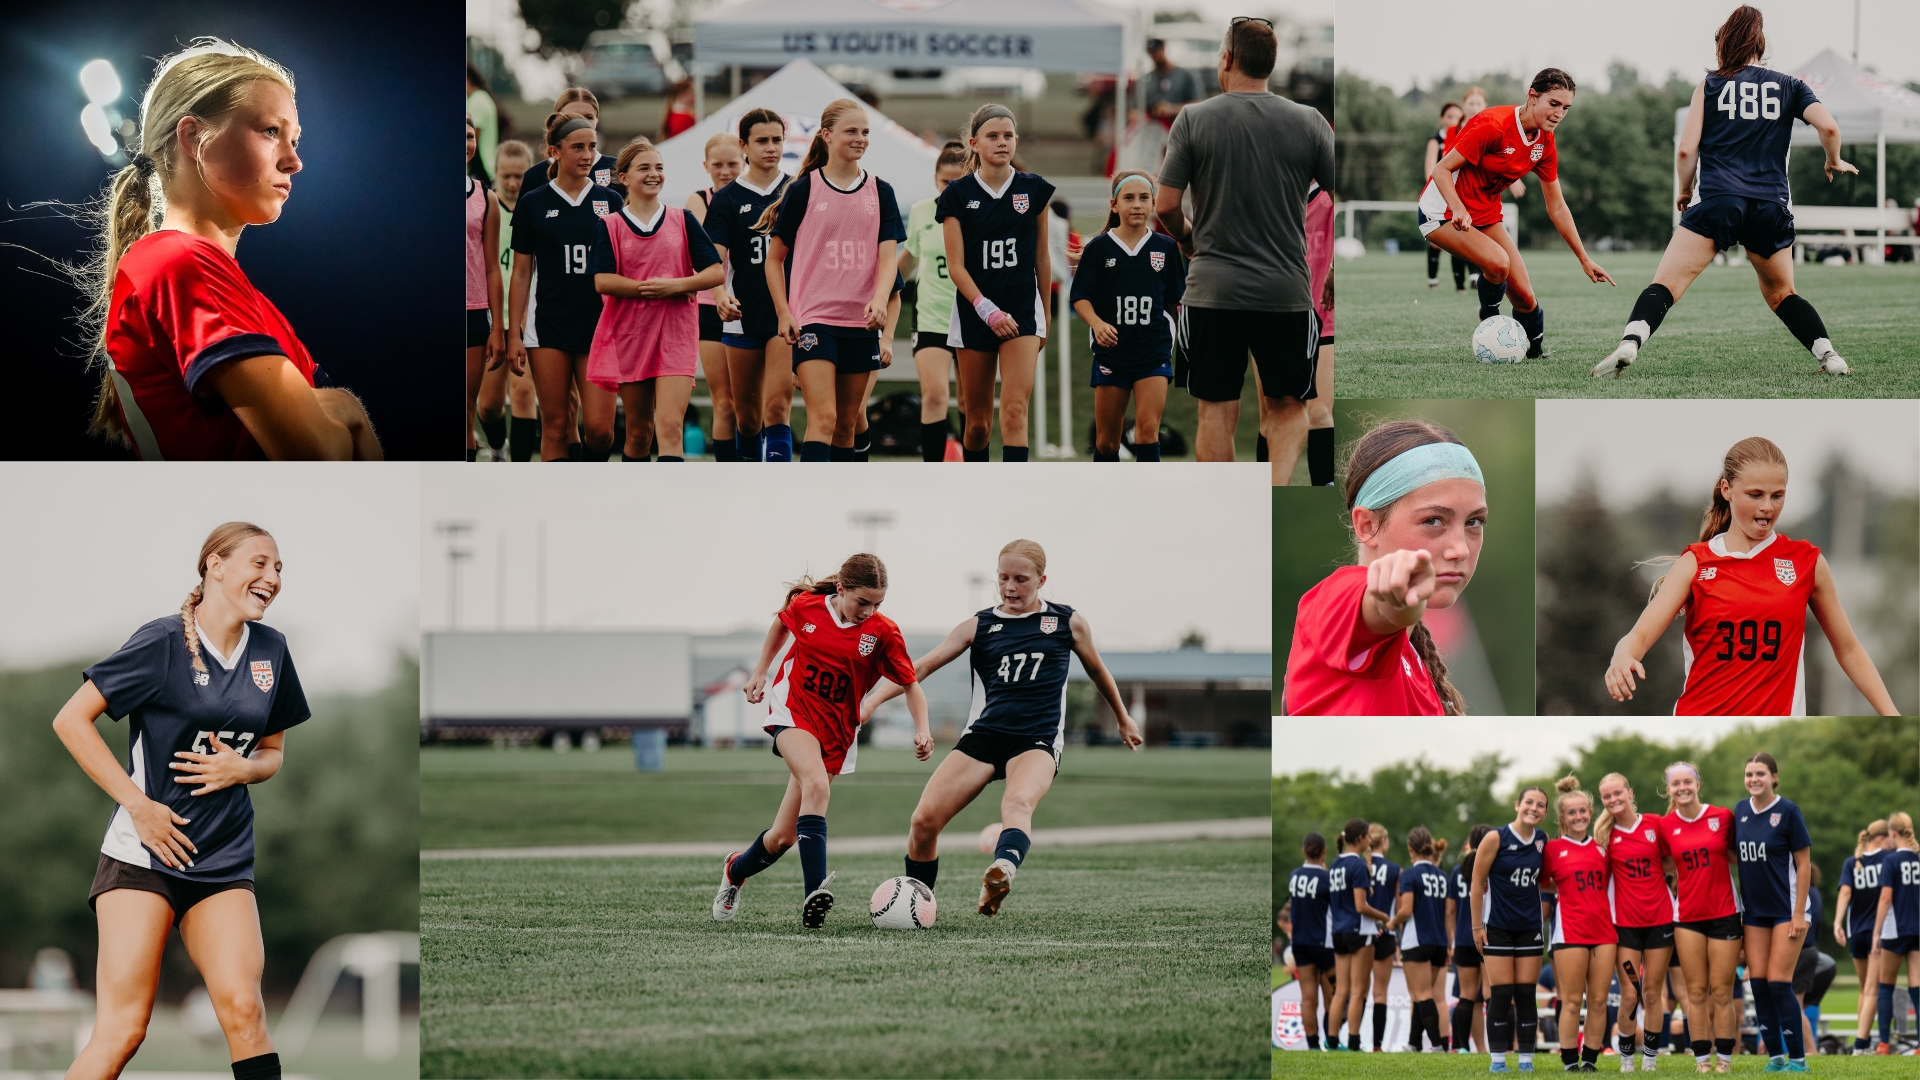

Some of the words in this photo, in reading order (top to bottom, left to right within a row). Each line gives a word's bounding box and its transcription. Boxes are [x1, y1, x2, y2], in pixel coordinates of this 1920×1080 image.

[782, 32, 817, 53] US
[828, 32, 917, 54] YOUTH
[927, 33, 1034, 57] SOCCER
[1717, 80, 1781, 120] 486
[564, 244, 592, 274] 19
[825, 240, 867, 270] 399
[983, 238, 1018, 269] 193
[1116, 296, 1152, 325] 189
[1716, 620, 1781, 661] 399
[998, 652, 1044, 682] 477
[803, 664, 851, 703] 398
[1682, 847, 1710, 870] 513
[1739, 841, 1767, 862] 804
[1510, 868, 1540, 886] 464
[1575, 870, 1602, 891] 543
[1625, 858, 1651, 878] 512
[1289, 874, 1319, 899] 494
[1421, 873, 1447, 898] 533
